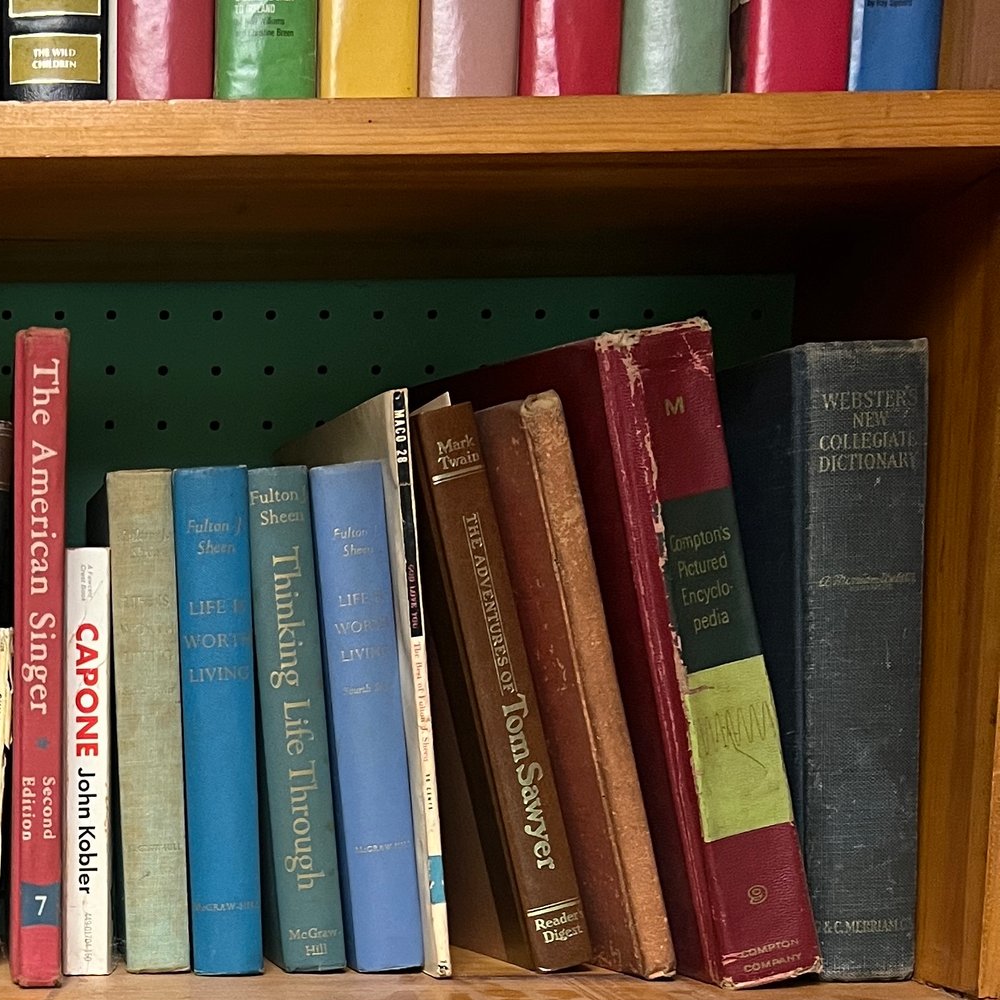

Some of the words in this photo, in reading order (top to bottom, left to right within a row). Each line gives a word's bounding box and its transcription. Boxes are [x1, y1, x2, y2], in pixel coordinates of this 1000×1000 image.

[32, 60, 77, 69] CHILDREN
[33, 48, 50, 57] THE
[52, 48, 76, 57] WILD
[32, 358, 61, 425] The
[665, 396, 685, 416] M
[394, 409, 407, 443] MACO
[852, 411, 889, 428] NEW
[437, 434, 475, 455] Mark
[819, 431, 918, 452] COLLEGIATE
[396, 449, 408, 463] 28
[437, 451, 481, 471] Twain
[818, 451, 918, 473] DICTIONARY
[250, 487, 299, 506] Fulton
[30, 440, 58, 596] American
[260, 510, 304, 526] Sheen
[670, 526, 732, 553] Compton's
[677, 551, 728, 578] Pictured
[465, 512, 483, 550] THE
[474, 553, 511, 667] ADVENTURES
[501, 669, 515, 694] OF
[681, 580, 734, 606] Encyclo-
[189, 599, 226, 615] LIFE
[269, 545, 306, 690] Thinking
[693, 607, 730, 634] pedia
[21, 612, 56, 715] Singer
[75, 623, 99, 757] CAPONE
[283, 699, 315, 755] Life
[77, 767, 97, 819] John
[501, 694, 530, 763] Tom
[516, 761, 556, 870] Sawyer
[21, 777, 36, 841] Edition
[42, 777, 56, 839] Second
[284, 760, 326, 891] Through
[77, 826, 98, 895] Kobler
[34, 895, 48, 916] 7
[543, 925, 584, 944] Digest
[305, 943, 328, 956] Hill
[740, 937, 800, 960] COMPTON
[743, 952, 803, 974] COMPANY
